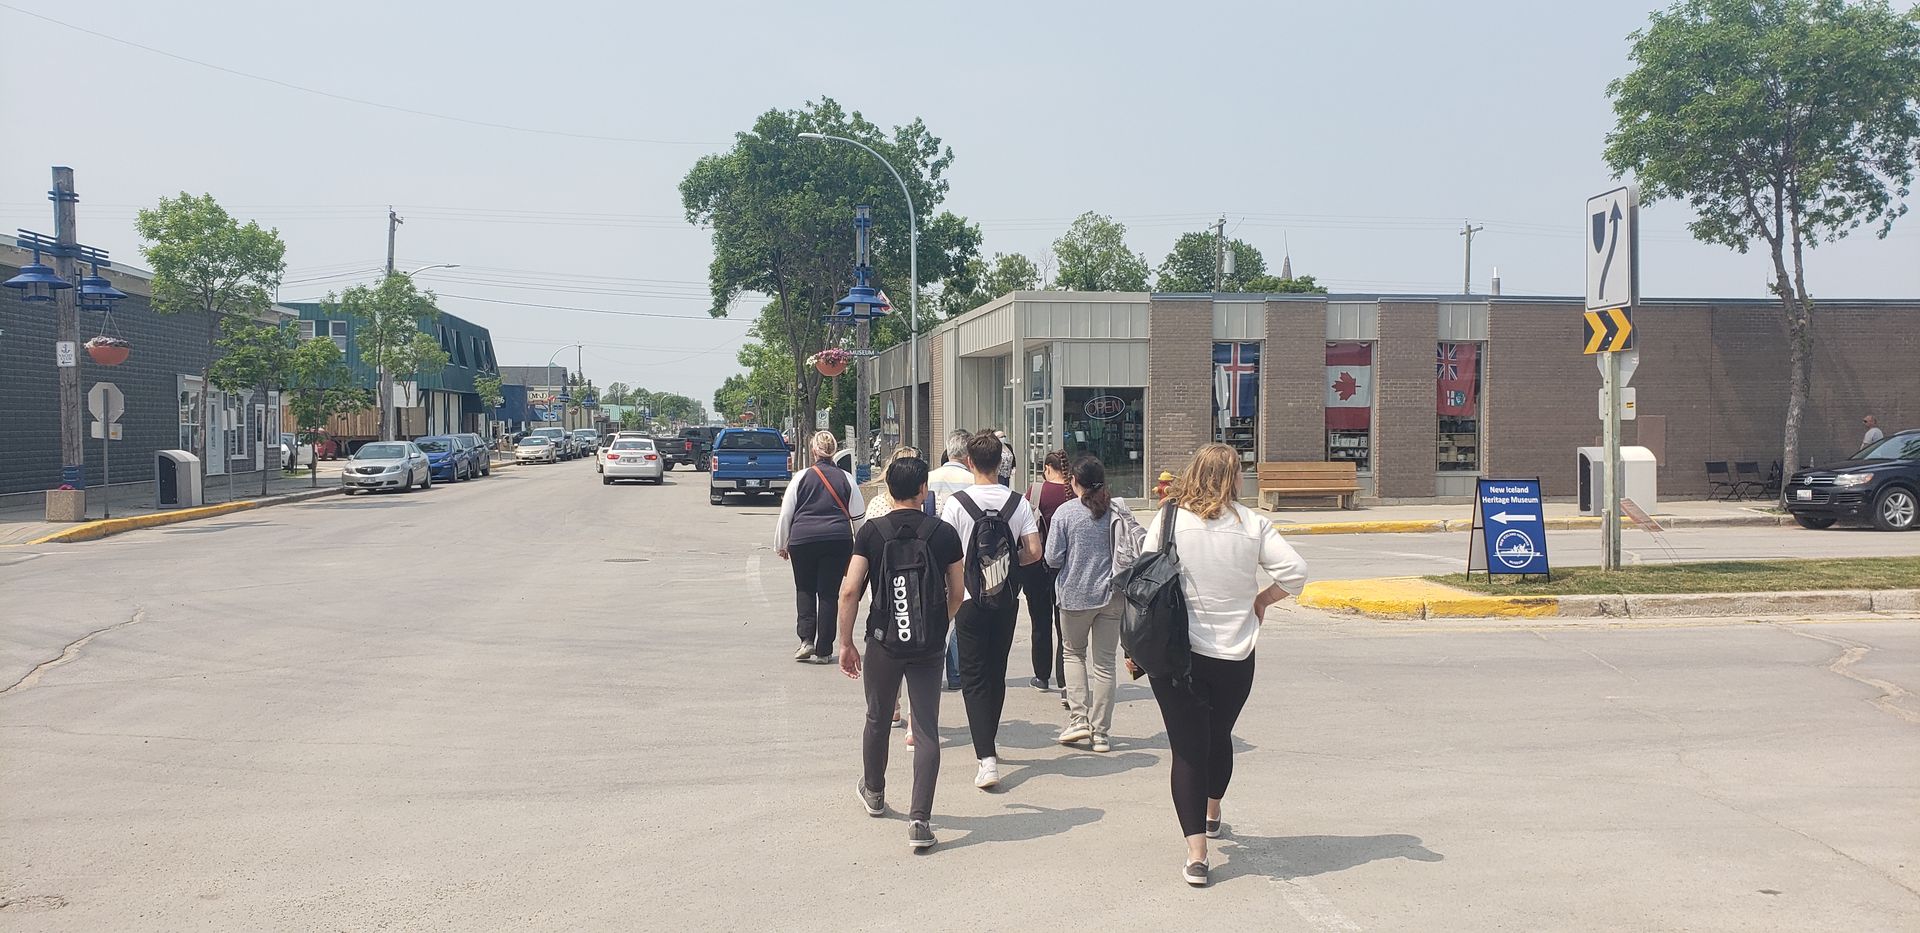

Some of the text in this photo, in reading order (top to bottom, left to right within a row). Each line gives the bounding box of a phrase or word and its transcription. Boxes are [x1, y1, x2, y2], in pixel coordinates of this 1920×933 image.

[1087, 400, 1121, 415] OPEN
[1482, 496, 1510, 504] Heritage
[893, 575, 912, 642] adidas
